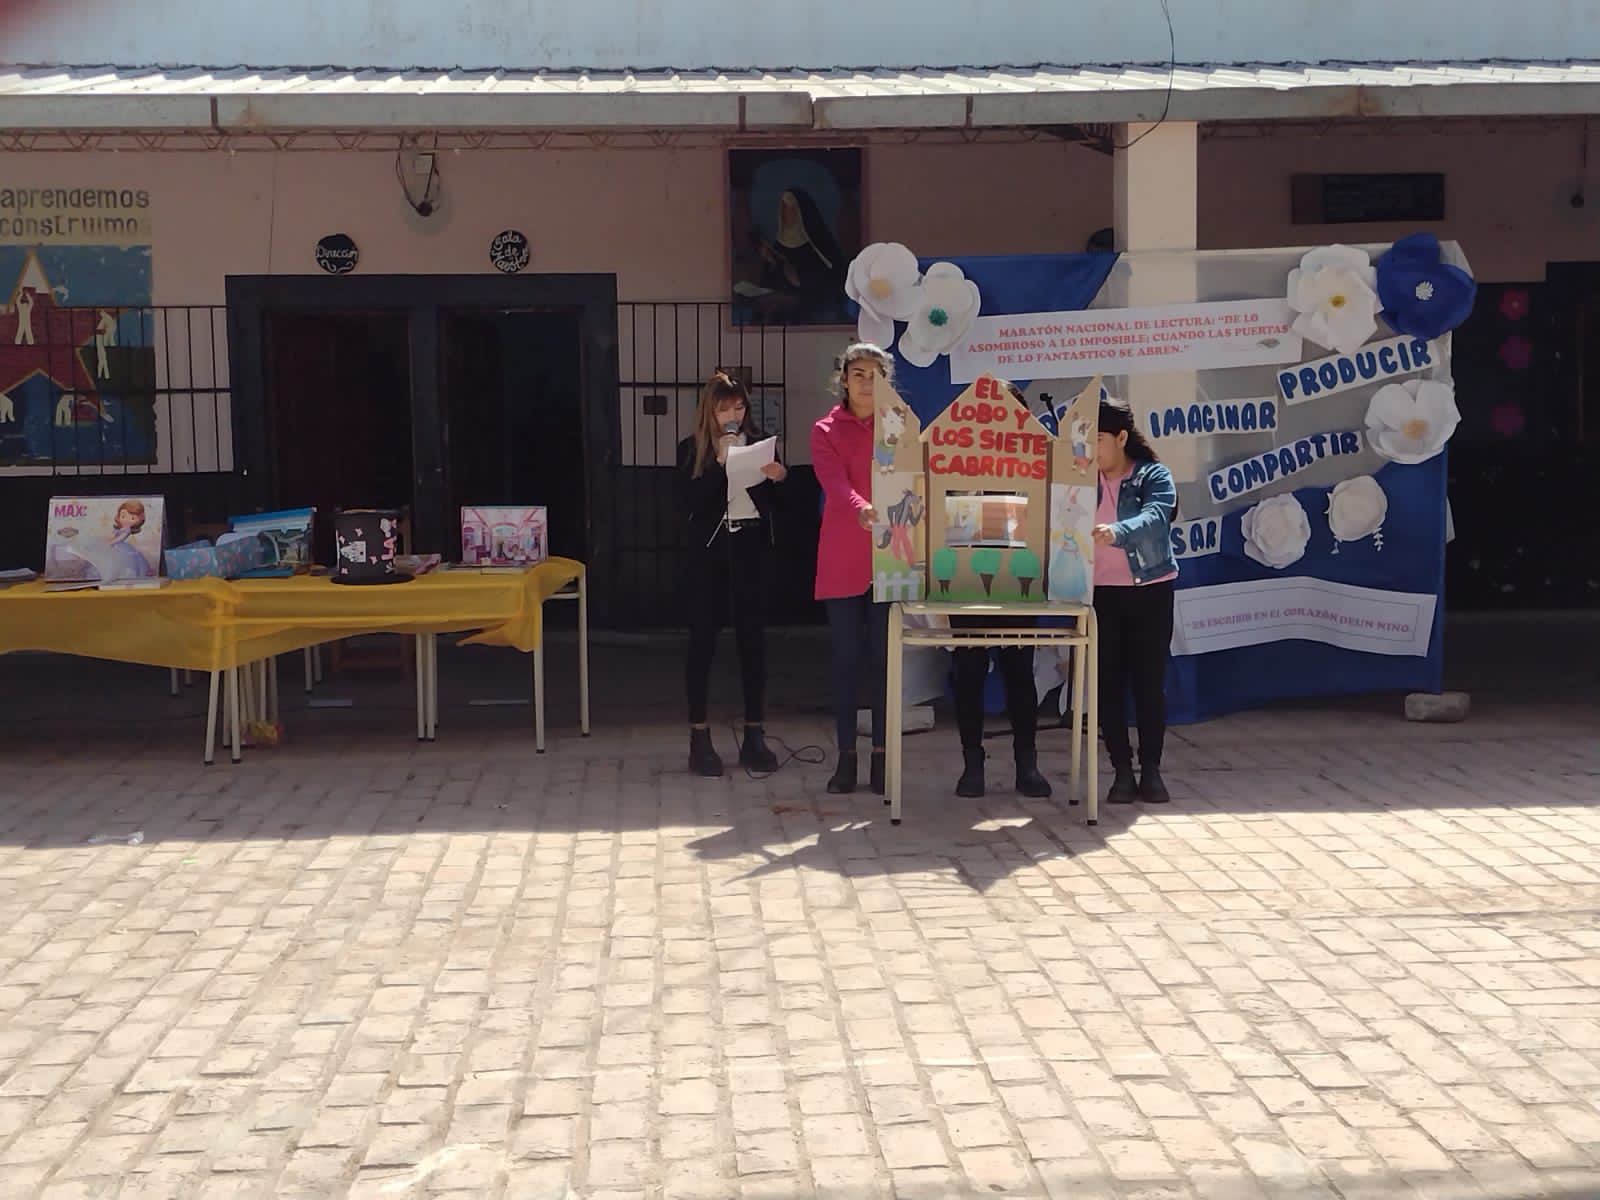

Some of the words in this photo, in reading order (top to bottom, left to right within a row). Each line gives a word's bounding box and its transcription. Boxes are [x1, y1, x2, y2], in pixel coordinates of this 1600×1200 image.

[0, 188, 150, 214] aprendemos
[0, 216, 148, 238] construimo
[968, 339, 1046, 353] ASOMBROSO
[1048, 338, 1058, 349] A
[1060, 337, 1077, 348] LO
[1152, 330, 1206, 343] CUANDO
[1208, 327, 1232, 338] LAS
[1234, 324, 1290, 338] PUERTAS
[999, 324, 1063, 338] MARATÓN
[1066, 320, 1132, 335] NACIONAL
[1134, 319, 1151, 331] DE
[1243, 313, 1259, 323] LO
[997, 353, 1015, 365] DE
[1018, 352, 1034, 364] LO
[1119, 347, 1133, 358] SE
[1279, 338, 1433, 400] PRODUCIR
[974, 376, 1005, 401] EL
[950, 401, 1009, 425] LOBO
[1013, 408, 1032, 431] Y
[1149, 401, 1277, 438] IMAGINAR
[931, 426, 975, 449] LOS
[979, 429, 1048, 456] SIETE
[928, 453, 1048, 481] CABRITOS
[1209, 431, 1361, 502] COMPARTIR
[1168, 520, 1217, 556] SAR
